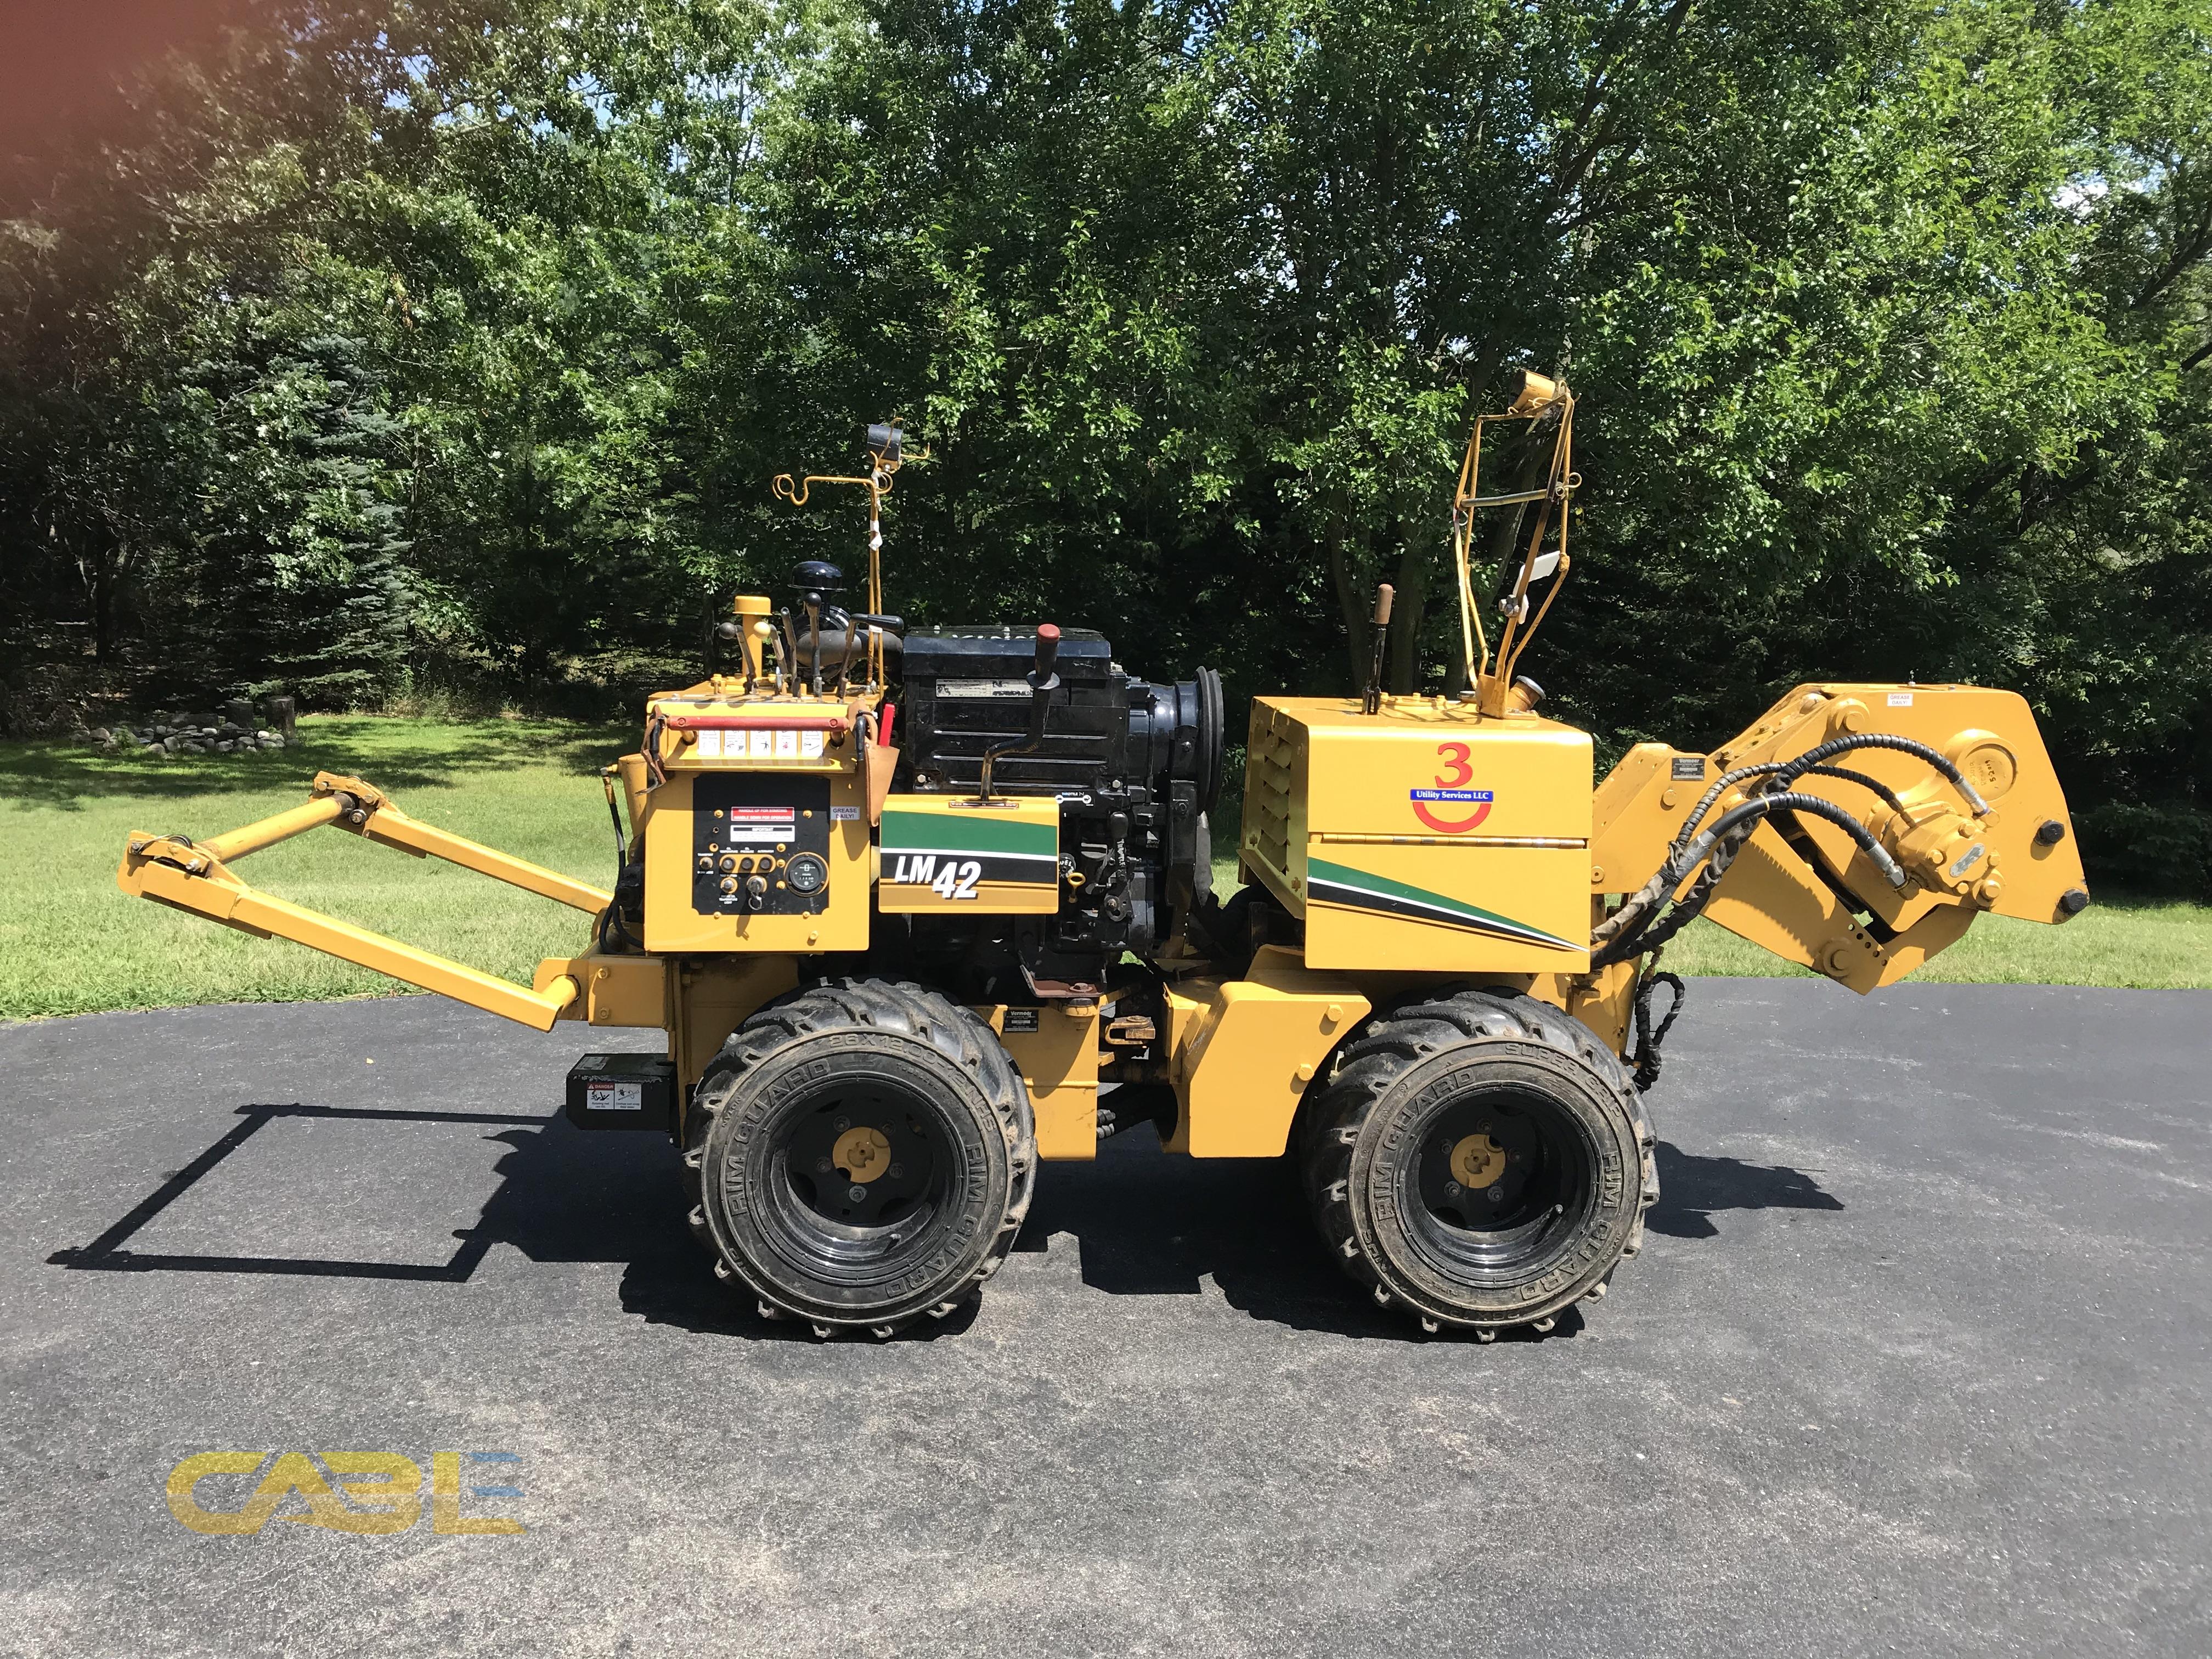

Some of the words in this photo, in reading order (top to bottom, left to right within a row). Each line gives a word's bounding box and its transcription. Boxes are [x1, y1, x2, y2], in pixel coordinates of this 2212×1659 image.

[1417, 791, 1440, 800] Utility
[1442, 791, 1472, 799] Services
[1435, 742, 1473, 788] 3
[894, 855, 937, 884] LM
[932, 861, 983, 900] 42
[1505, 1042, 1580, 1076] SUPER
[734, 1058, 831, 1145] GUARD
[1382, 1068, 1477, 1151] GUARD
[725, 1154, 748, 1217] RIM
[966, 1141, 988, 1203] RIM
[1372, 1161, 1397, 1221] RIM
[1602, 1150, 1622, 1209] RIM
[884, 1214, 978, 1297] GUARD
[1520, 1219, 1613, 1301] GUARD
